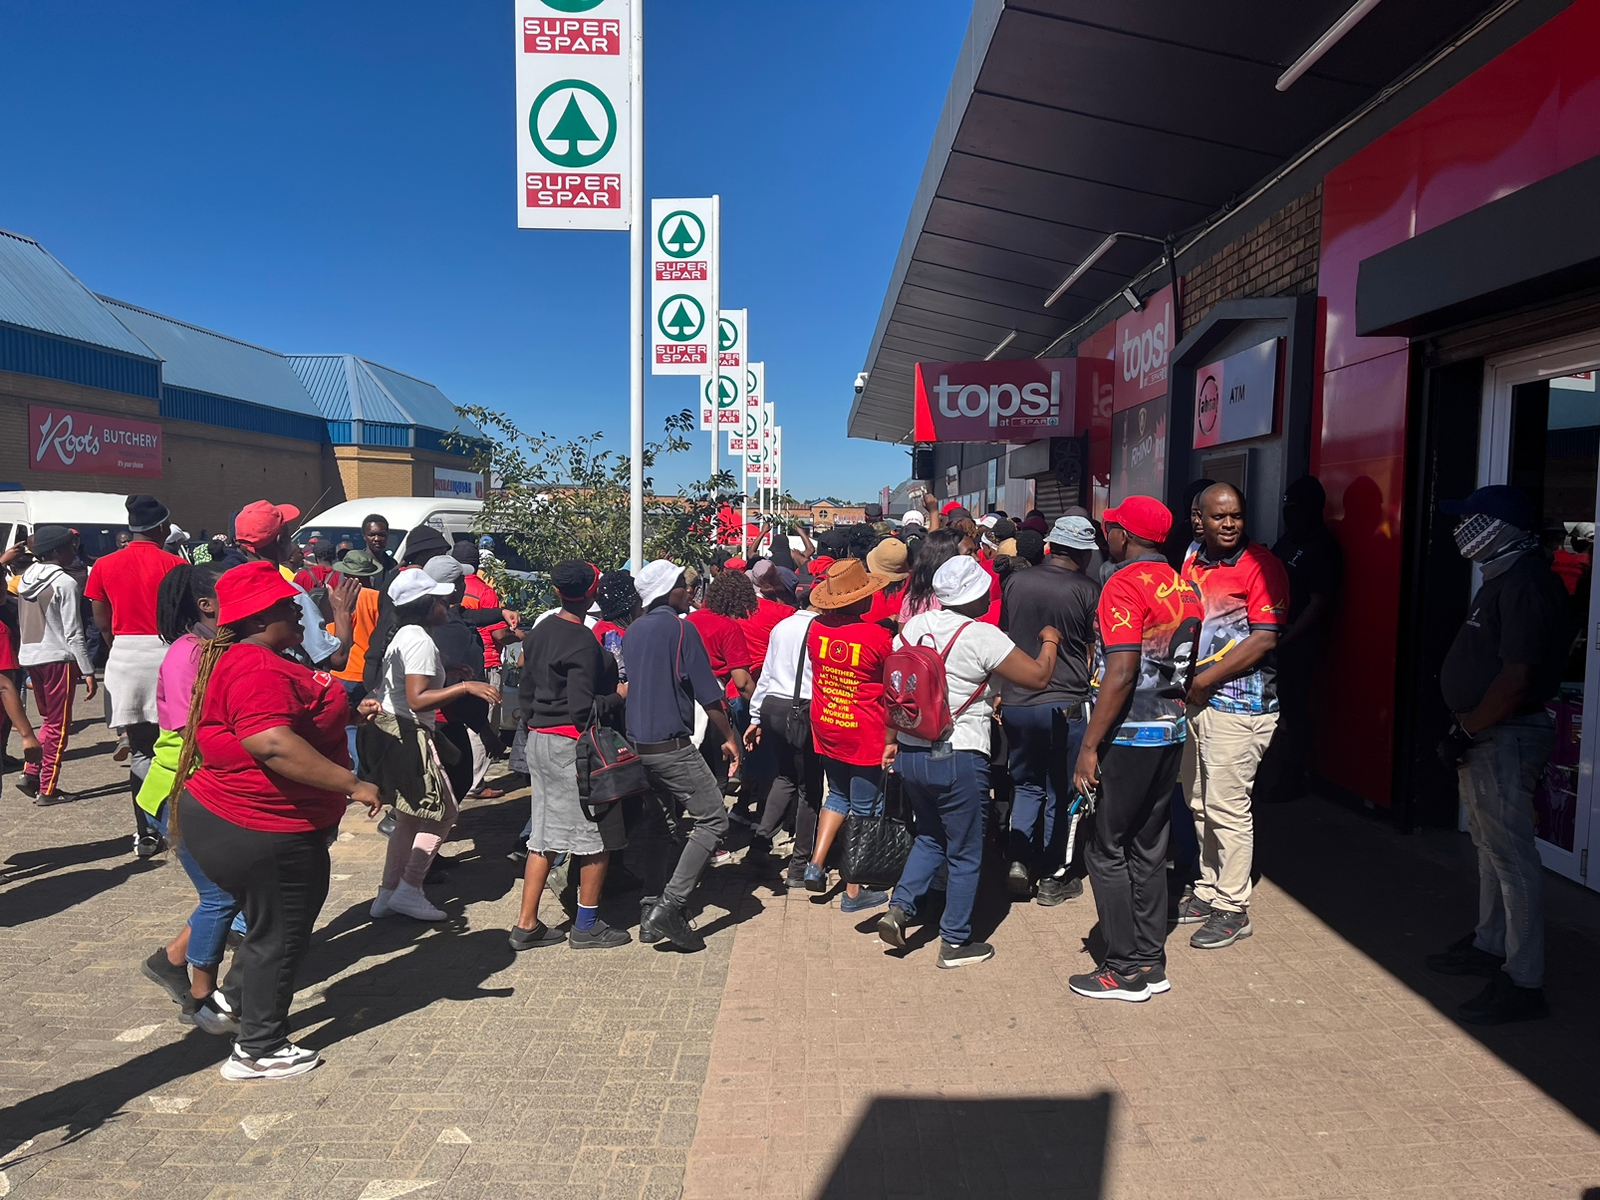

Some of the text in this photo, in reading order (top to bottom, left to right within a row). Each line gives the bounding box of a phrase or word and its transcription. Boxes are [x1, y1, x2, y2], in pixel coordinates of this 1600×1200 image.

[524, 20, 618, 36] SUPER
[536, 36, 608, 52] SPAR
[526, 176, 620, 190] SUPER
[538, 192, 610, 206] SPAR
[656, 262, 706, 271] SUPER
[662, 271, 701, 280] SPAR
[656, 346, 706, 354] SUPER
[1122, 302, 1170, 390] tops!
[662, 354, 701, 362] SPAR
[933, 371, 1060, 427] tops!
[1229, 384, 1245, 404] ATM
[36, 412, 158, 466] Roots BUTCHERY
[1131, 435, 1152, 468] RHINO
[822, 707, 854, 720] WORKERS
[820, 714, 858, 728] AND POOR!
